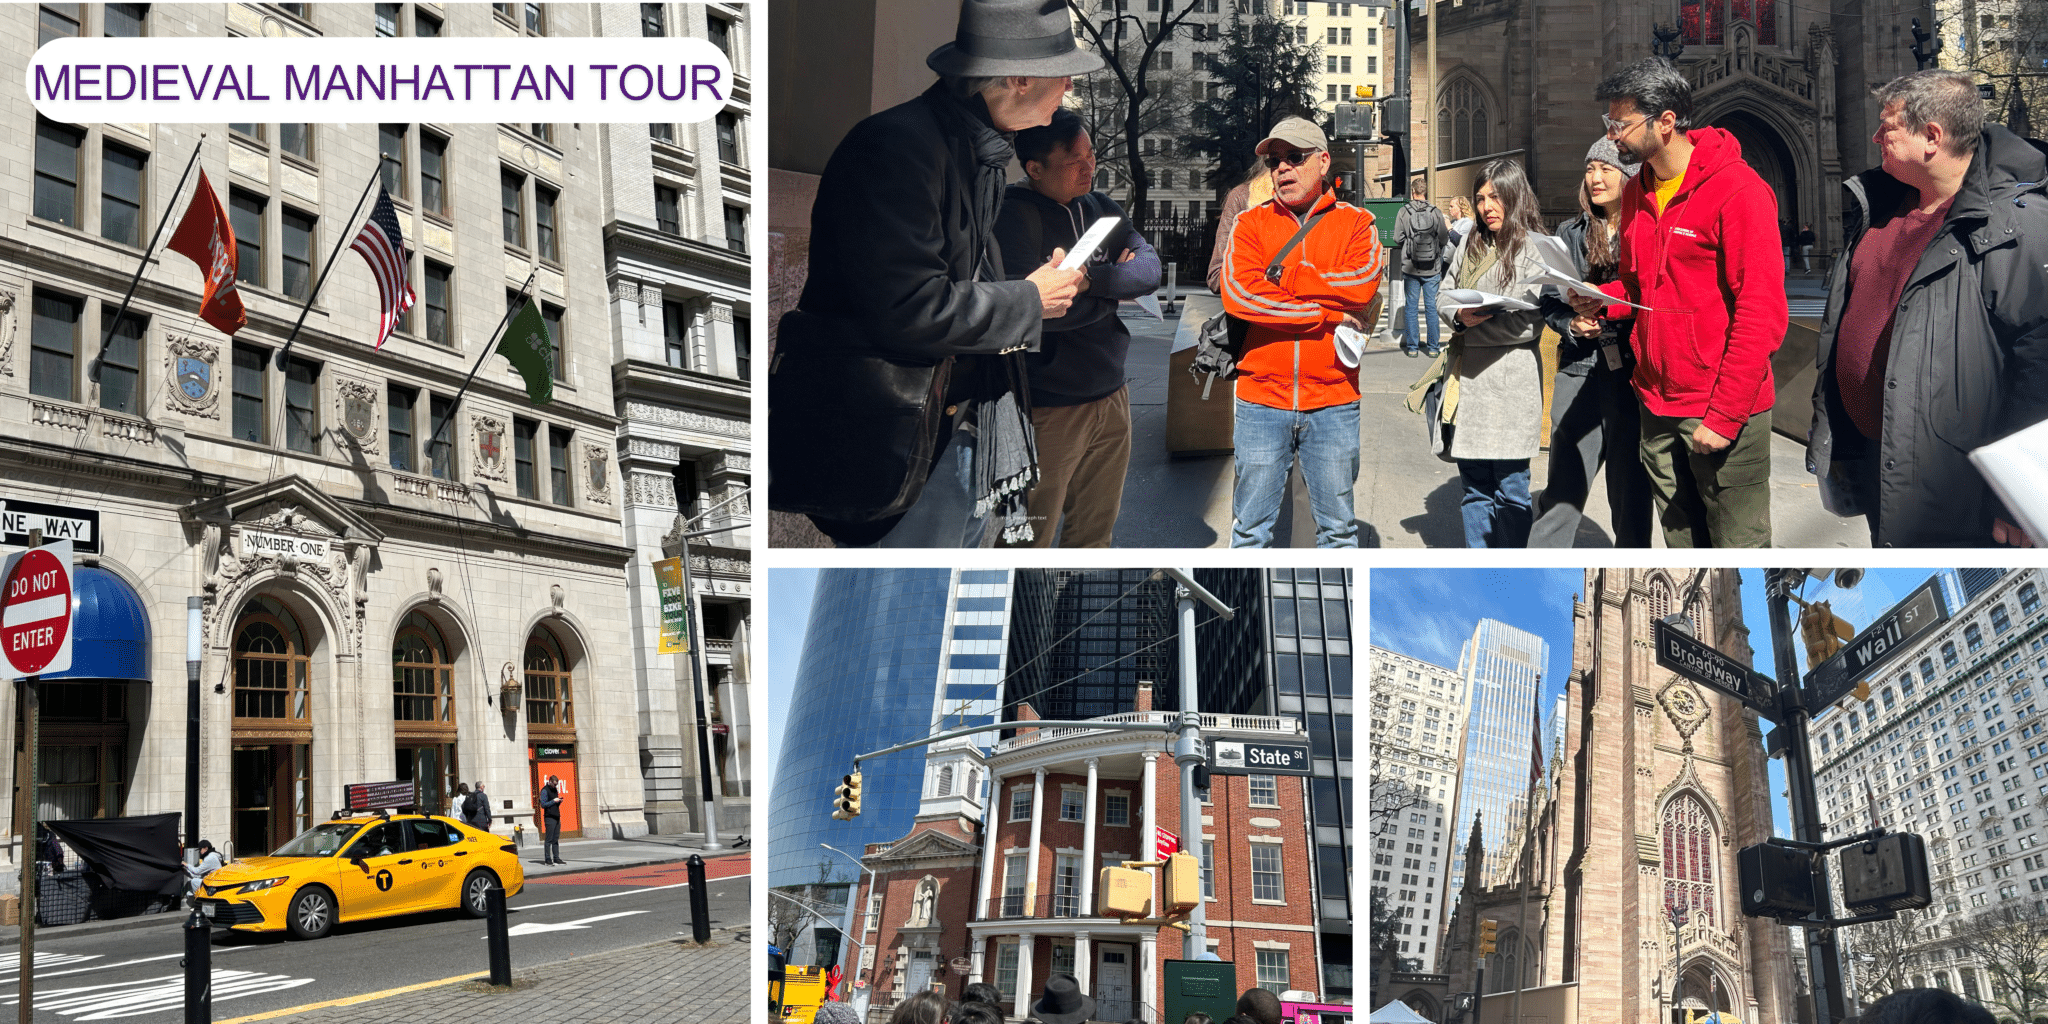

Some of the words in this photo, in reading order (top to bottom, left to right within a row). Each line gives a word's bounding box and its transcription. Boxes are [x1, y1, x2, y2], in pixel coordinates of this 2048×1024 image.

[2, 512, 27, 533] NE
[45, 517, 83, 539] WAY
[246, 534, 295, 553] NUMBER
[300, 541, 323, 557] ONE
[11, 577, 28, 598] DO
[33, 569, 58, 593] NOT
[663, 602, 682, 613] BIKE
[13, 626, 54, 652] ENTER
[1856, 620, 1902, 666] Wall
[1904, 604, 1919, 623] ST
[1670, 640, 1741, 692] Broadway
[1702, 649, 1725, 667] 60-90
[1249, 747, 1291, 766] State
[1293, 750, 1303, 760] St
[379, 873, 389, 889] T
